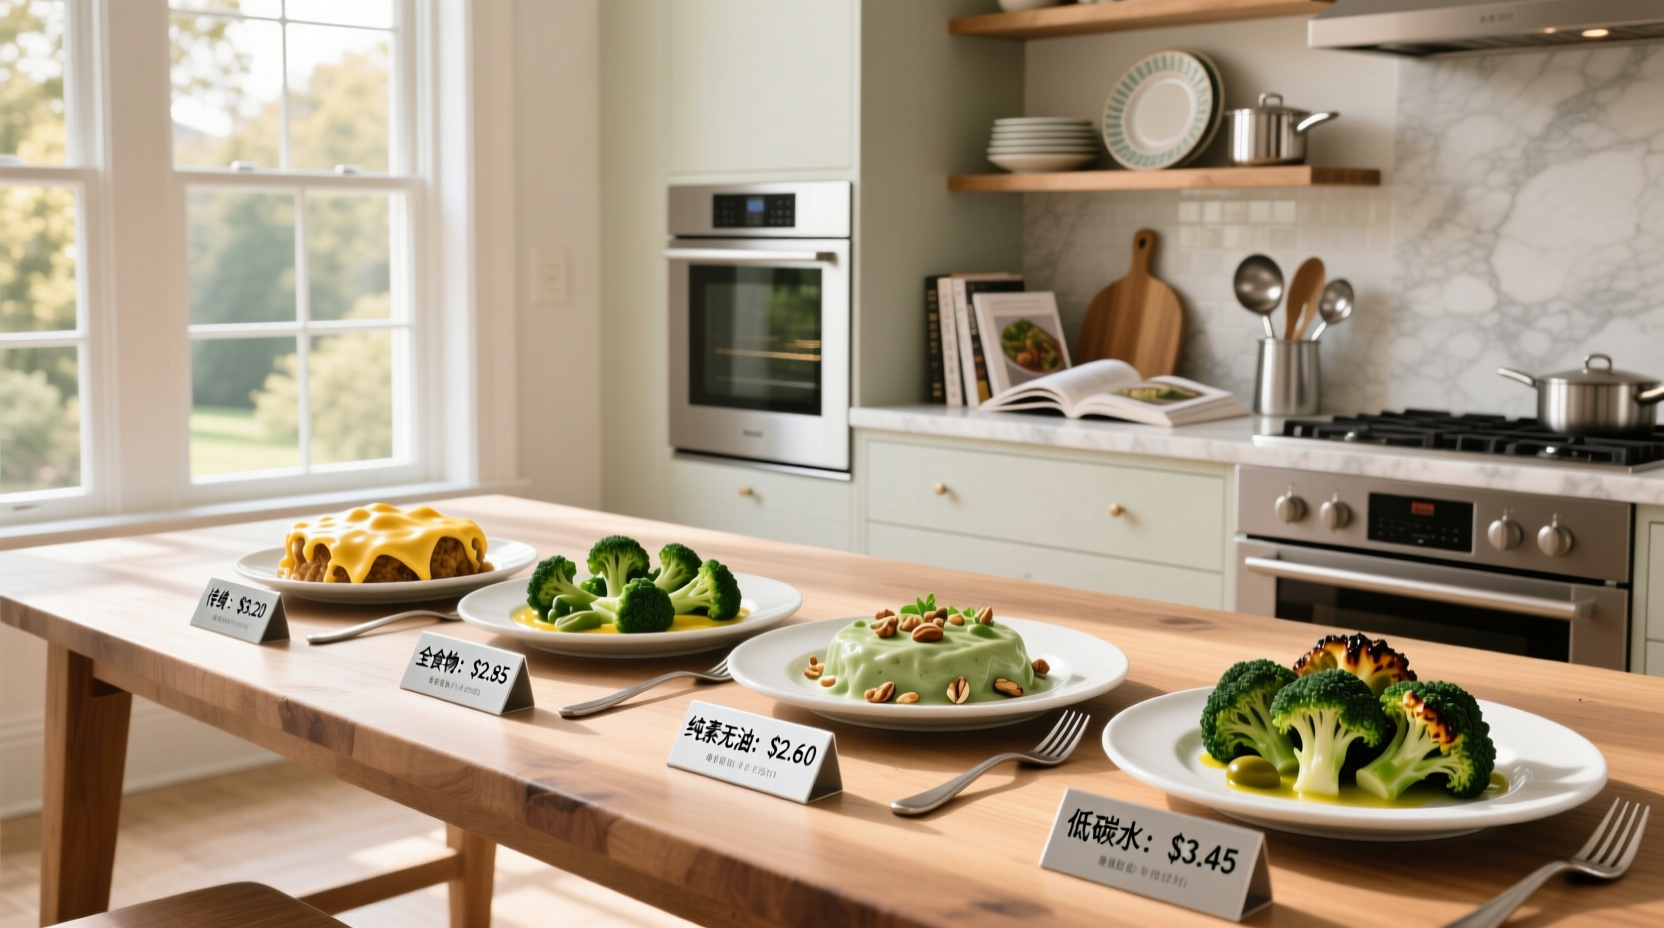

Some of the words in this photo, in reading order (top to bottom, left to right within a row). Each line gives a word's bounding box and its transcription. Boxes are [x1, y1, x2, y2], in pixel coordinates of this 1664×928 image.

[237, 596, 267, 618] $3.20
[470, 659, 510, 684] $2.85
[767, 735, 817, 766] $2.60
[1168, 832, 1239, 874] $3.45
